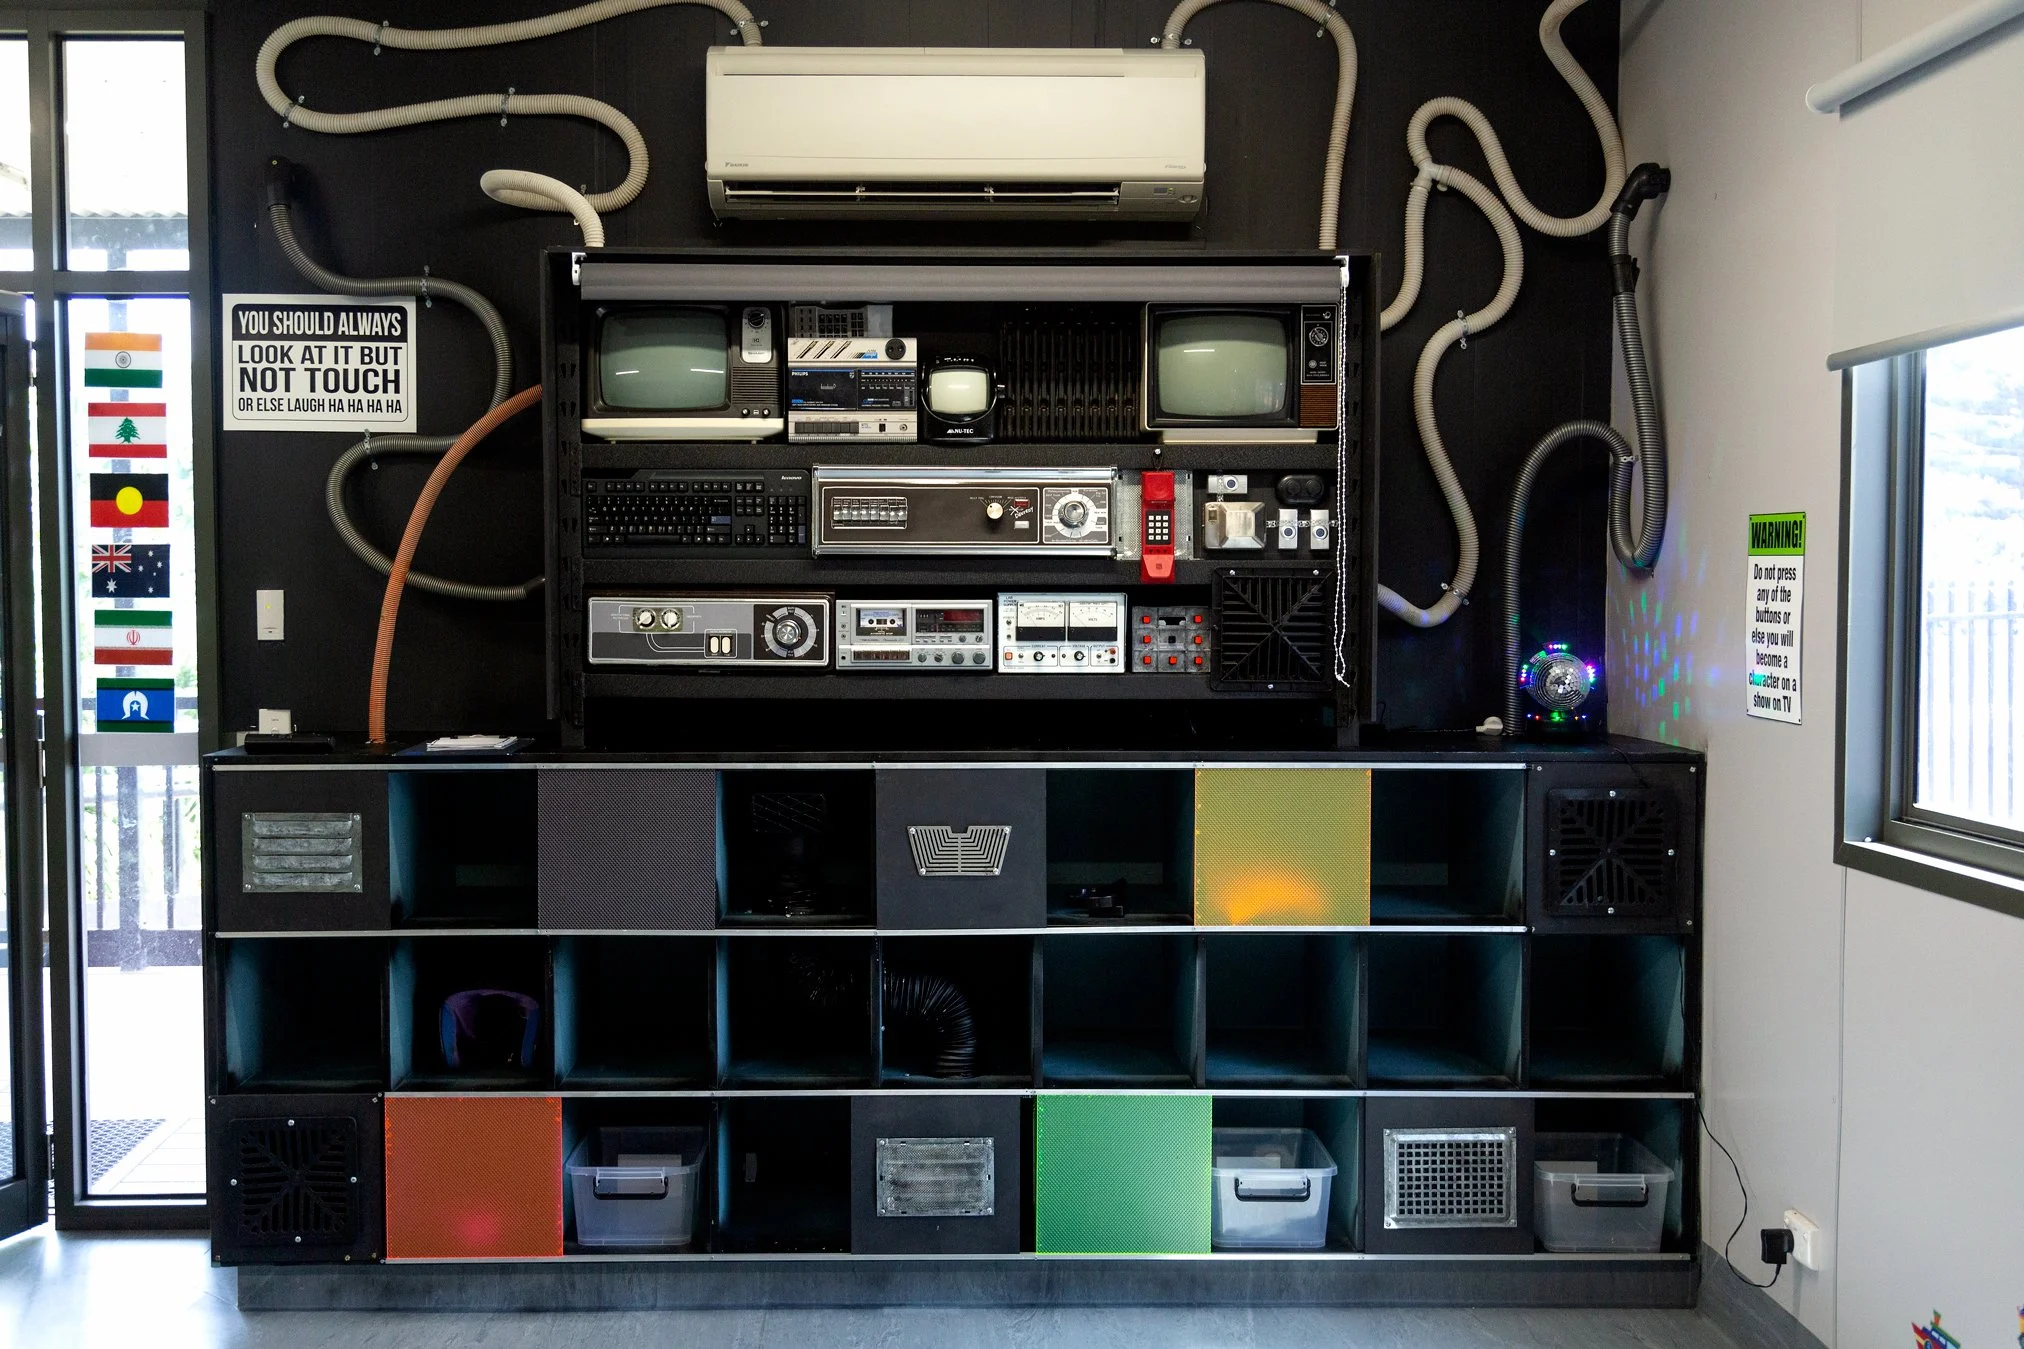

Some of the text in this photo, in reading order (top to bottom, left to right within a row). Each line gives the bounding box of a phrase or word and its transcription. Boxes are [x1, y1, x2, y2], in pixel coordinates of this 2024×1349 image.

[238, 310, 402, 336] YOU SHOULD ALWAYS
[238, 344, 402, 366] LOOK AT IT BUT
[239, 367, 401, 394] NOT TOUCH
[238, 397, 402, 414] OR ELSE LAUGH HA HA HA HA
[1751, 519, 1803, 549] WARNING!
[1754, 563, 1797, 584] Do not press
[1757, 585, 1792, 605] any of the
[1755, 606, 1791, 625] buttons or
[1752, 628, 1794, 649] else you will
[1756, 649, 1788, 669] become a
[1781, 677, 1790, 690] on
[1792, 678, 1797, 692] a
[1753, 691, 1791, 713] show on TV
